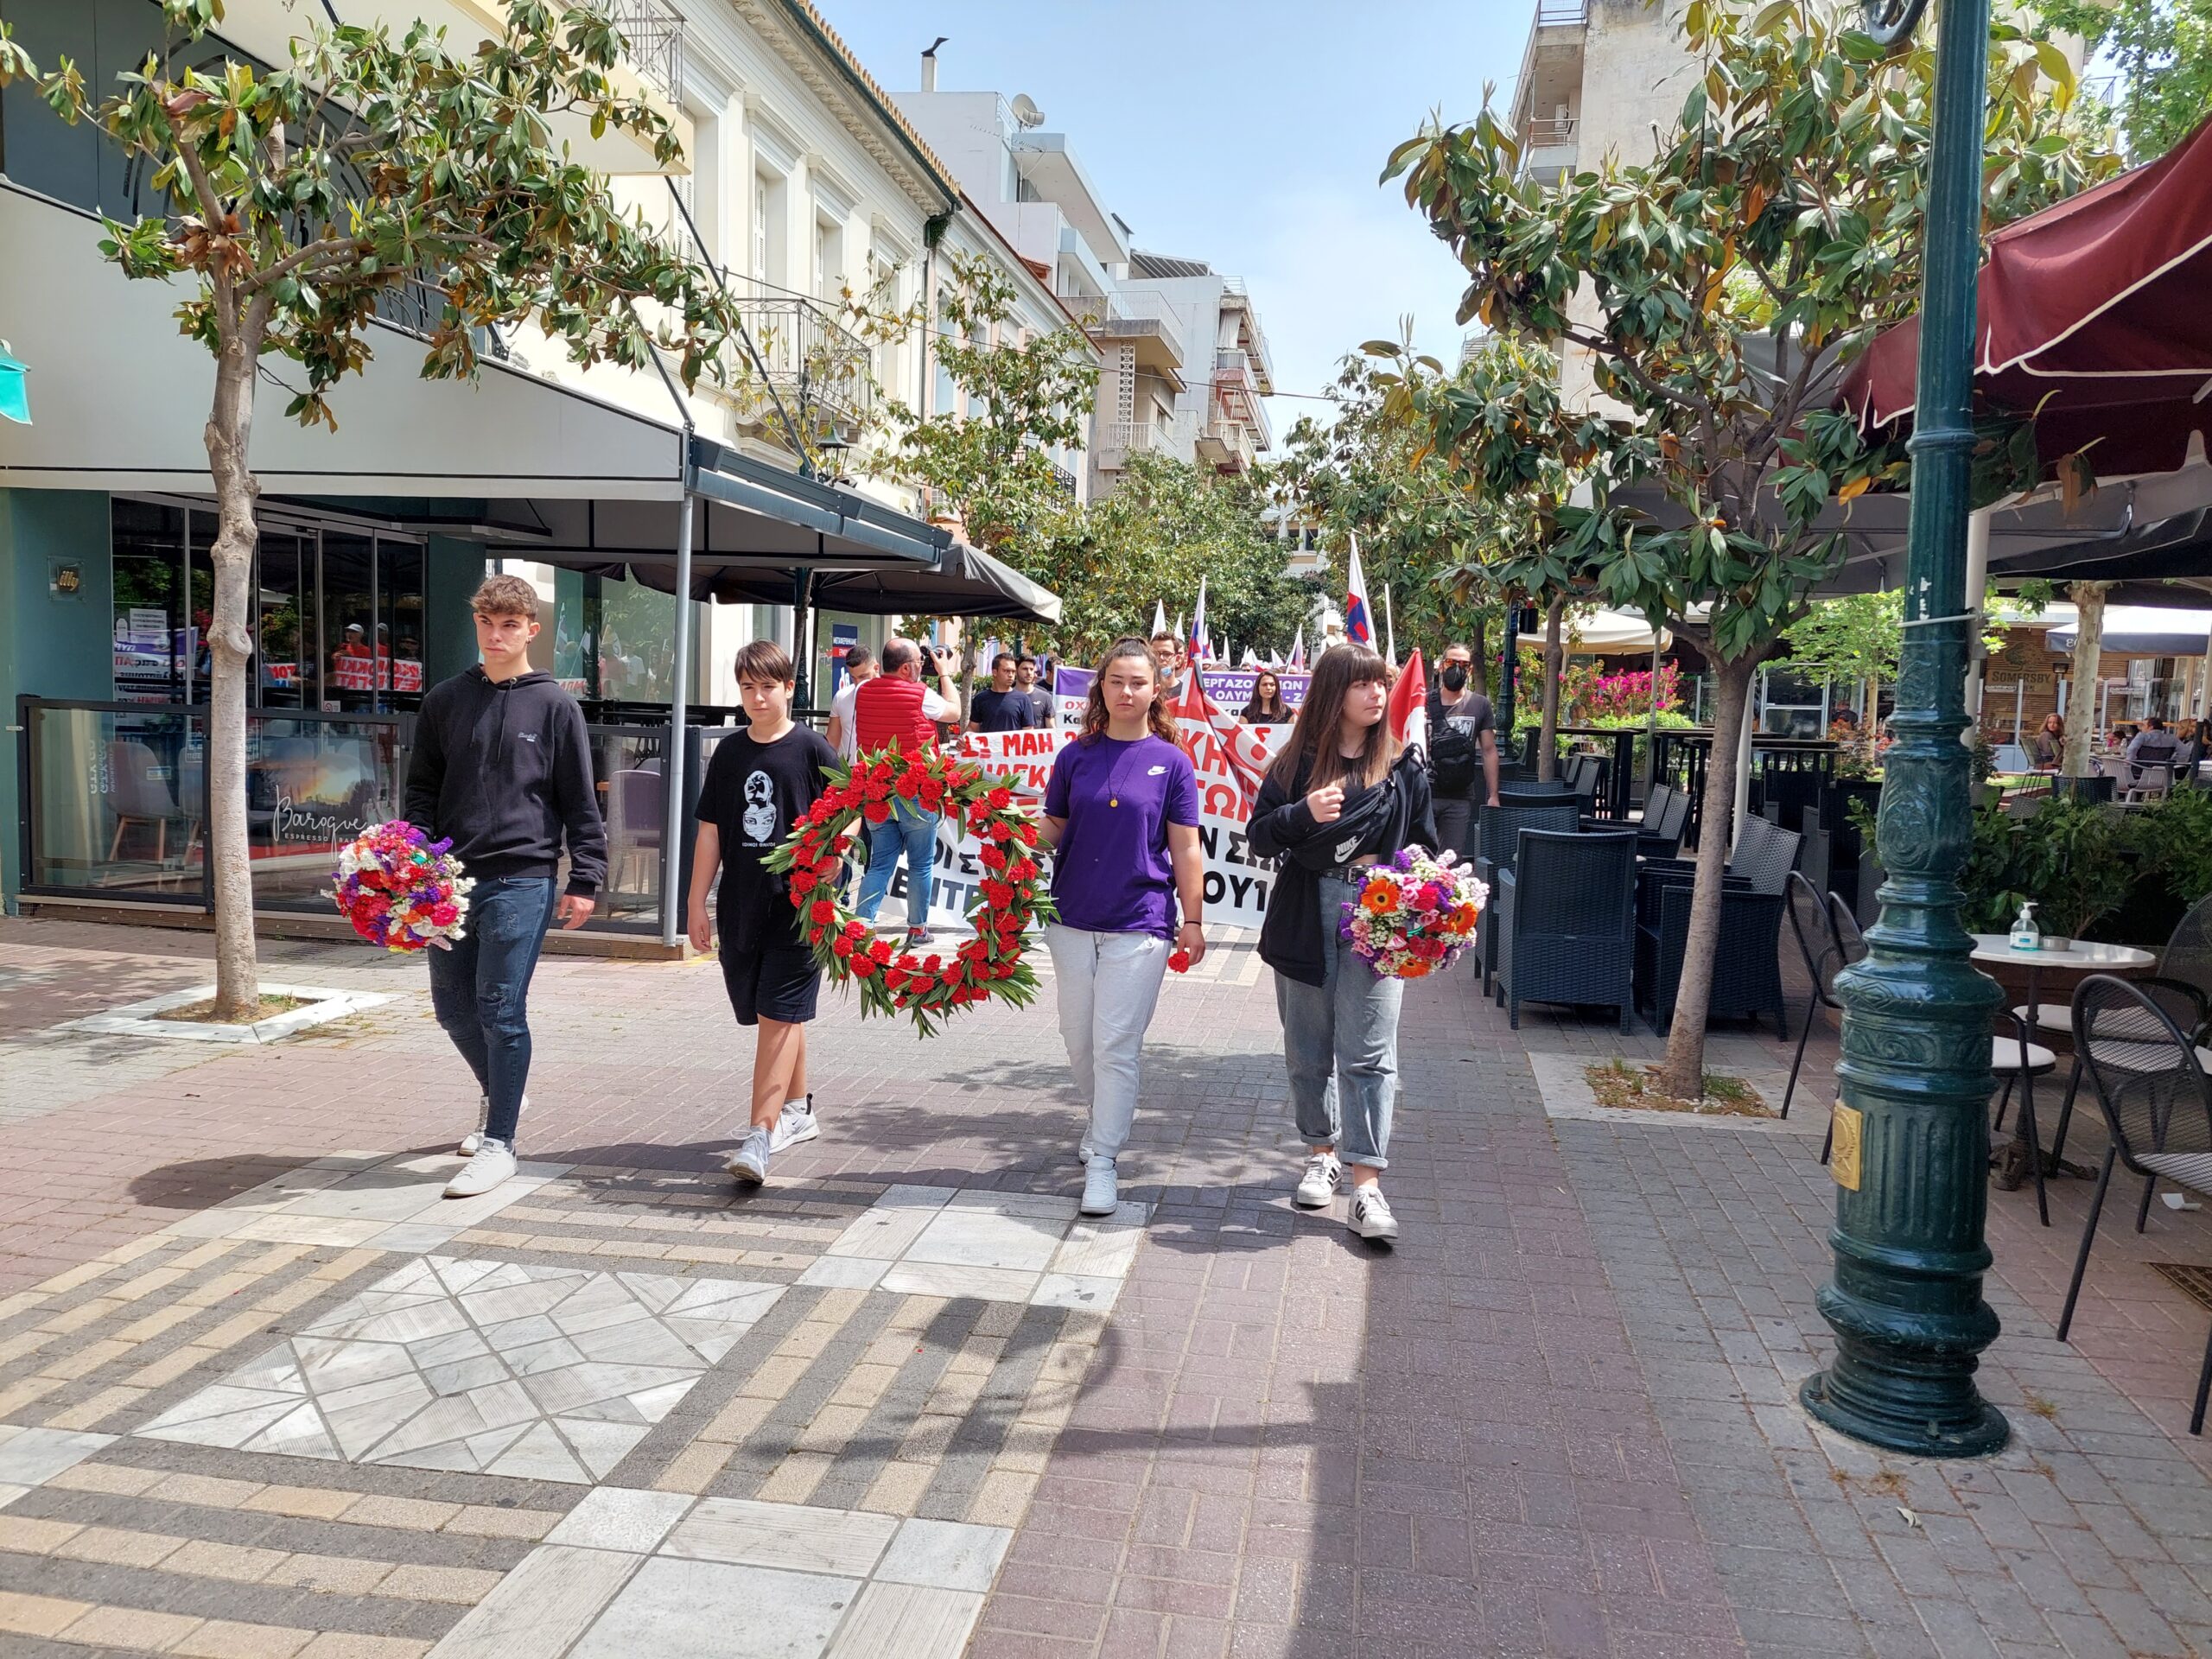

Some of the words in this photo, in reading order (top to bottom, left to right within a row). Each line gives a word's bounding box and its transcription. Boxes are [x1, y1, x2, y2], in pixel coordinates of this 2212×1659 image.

[59, 570, 79, 592] illy
[1992, 671, 2051, 683] SOMERSBY
[1002, 733, 1053, 757] ΜΑΗ
[284, 832, 328, 842] ESPRESSO
[1336, 835, 1357, 855] NIKE
